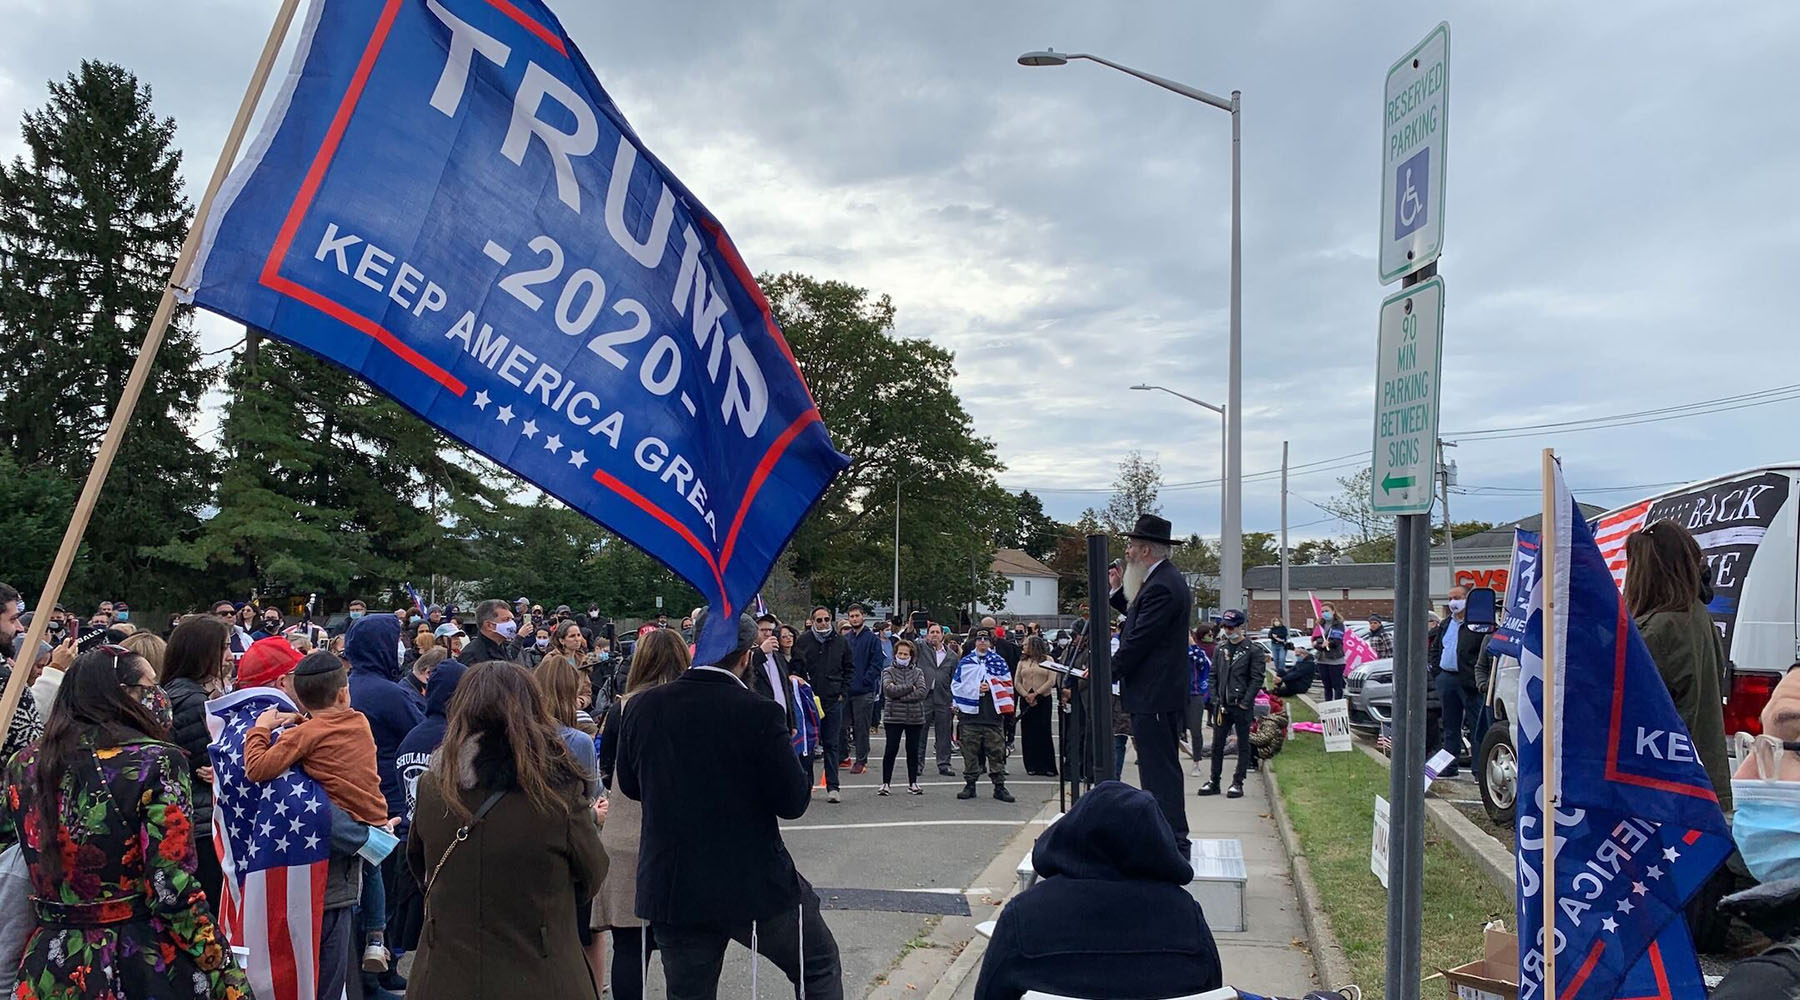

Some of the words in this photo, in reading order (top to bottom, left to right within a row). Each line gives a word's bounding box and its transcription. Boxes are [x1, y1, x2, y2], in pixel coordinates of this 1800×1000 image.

[1387, 61, 1443, 129] RESERVED
[1390, 104, 1437, 162] PARKING
[426, 0, 769, 439] TRUMP
[1401, 313, 1417, 342] 90
[1397, 342, 1416, 373] MIN
[314, 222, 447, 318] KEEP
[445, 310, 624, 449] AMERICA
[634, 436, 719, 552] GREA
[1383, 370, 1429, 407] PARKING
[1381, 403, 1429, 438] BETWEEN
[1388, 438, 1420, 468] SIGNS
[1687, 484, 1775, 529] BACK
[1455, 569, 1509, 592] CVS
[396, 752, 431, 769] SHULAM
[1636, 726, 1704, 767] KE
